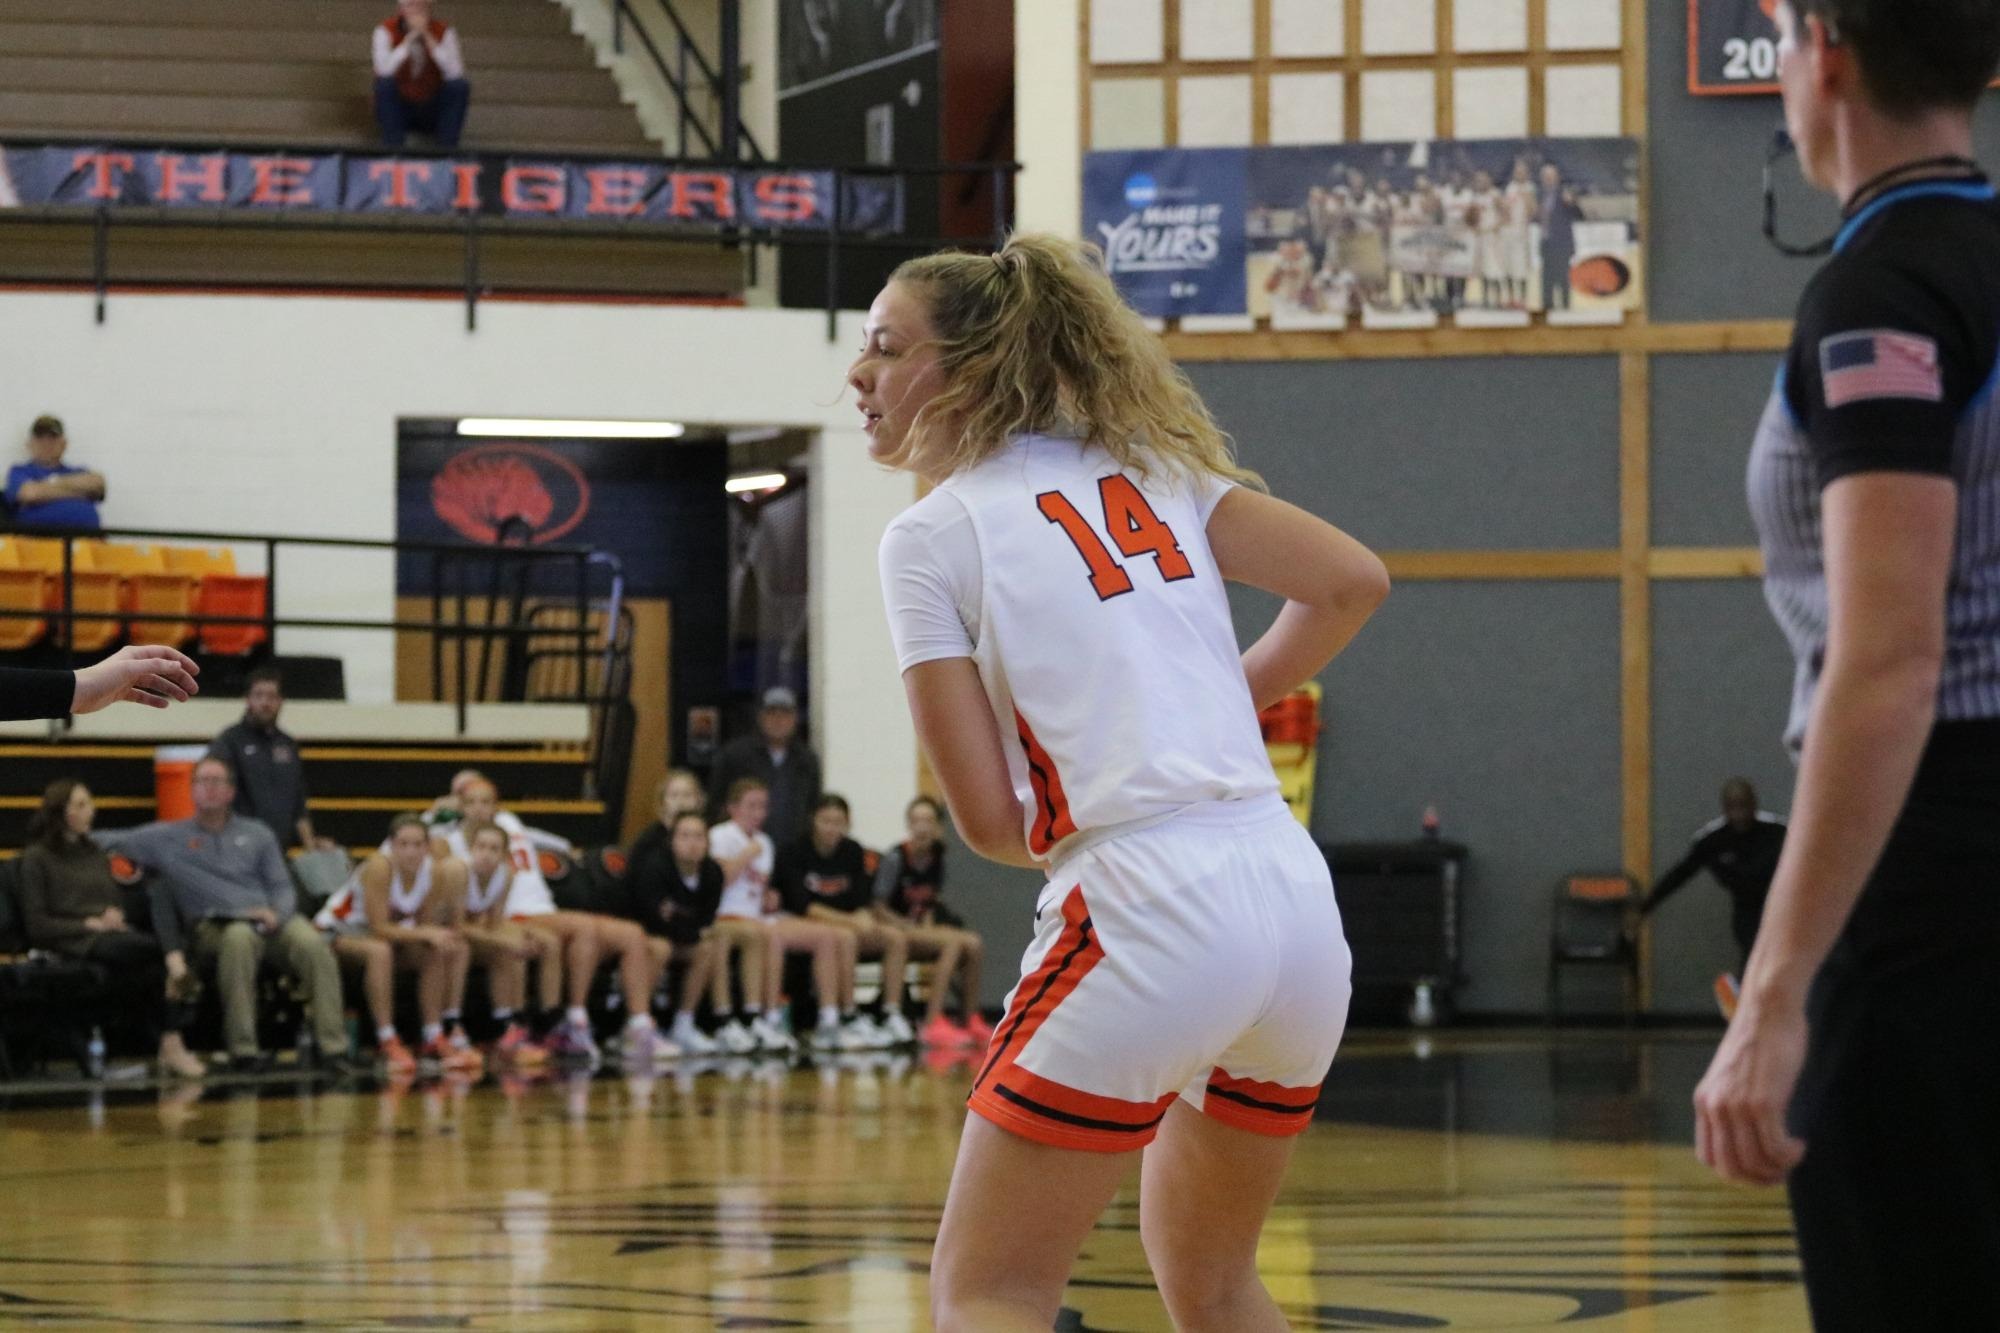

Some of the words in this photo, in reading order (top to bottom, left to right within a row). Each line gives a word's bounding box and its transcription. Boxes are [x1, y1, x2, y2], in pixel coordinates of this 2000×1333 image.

[1722, 37, 1784, 79] 20
[73, 152, 312, 204] THE
[370, 161, 817, 221] TIGERS
[1036, 473, 1195, 601] 14
